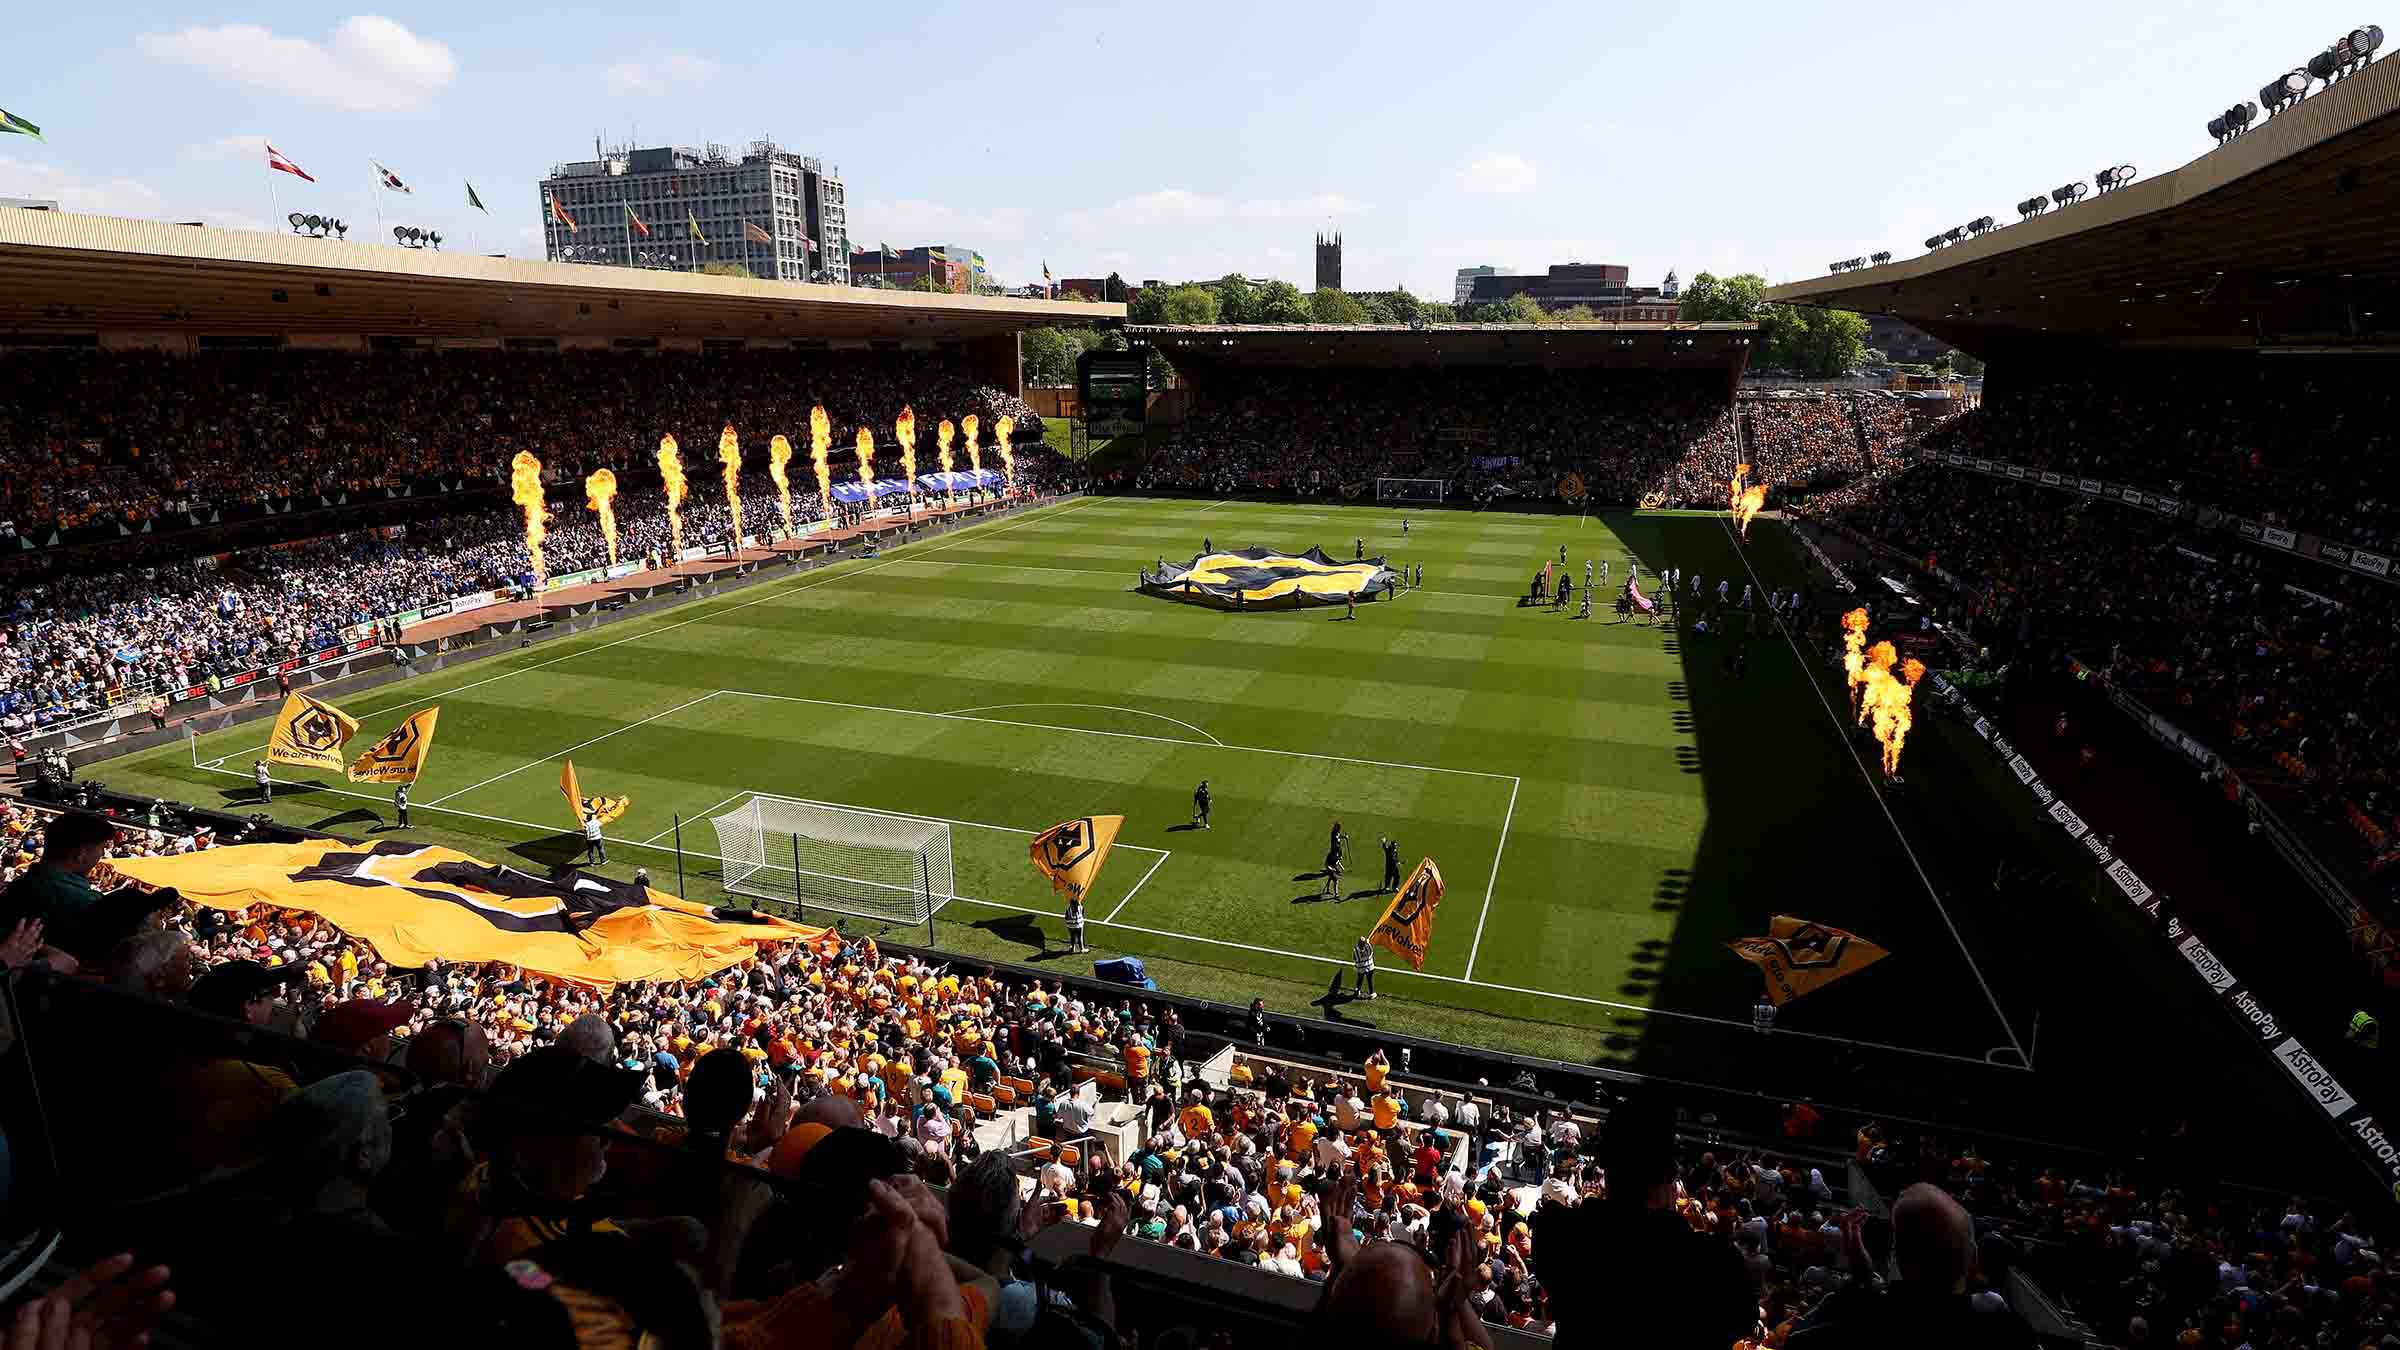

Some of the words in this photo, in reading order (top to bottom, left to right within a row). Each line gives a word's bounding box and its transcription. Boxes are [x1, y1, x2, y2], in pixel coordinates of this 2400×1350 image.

[424, 604, 451, 618] AstroPay
[346, 638, 376, 653] 12BET
[308, 648, 339, 664] 12BET
[221, 672, 257, 688] 12BET
[174, 685, 207, 701] 12BE
[272, 748, 288, 758] We
[2054, 805, 2083, 833] AstroPay
[2082, 832, 2113, 865] AstroPay
[2112, 863, 2146, 898] AstroPay
[2187, 943, 2227, 985] AstroPay
[943, 985, 950, 995] 8
[2232, 990, 2283, 1041] AstroPay
[950, 1079, 958, 1090] 7
[2286, 1048, 2344, 1105] AstroPay
